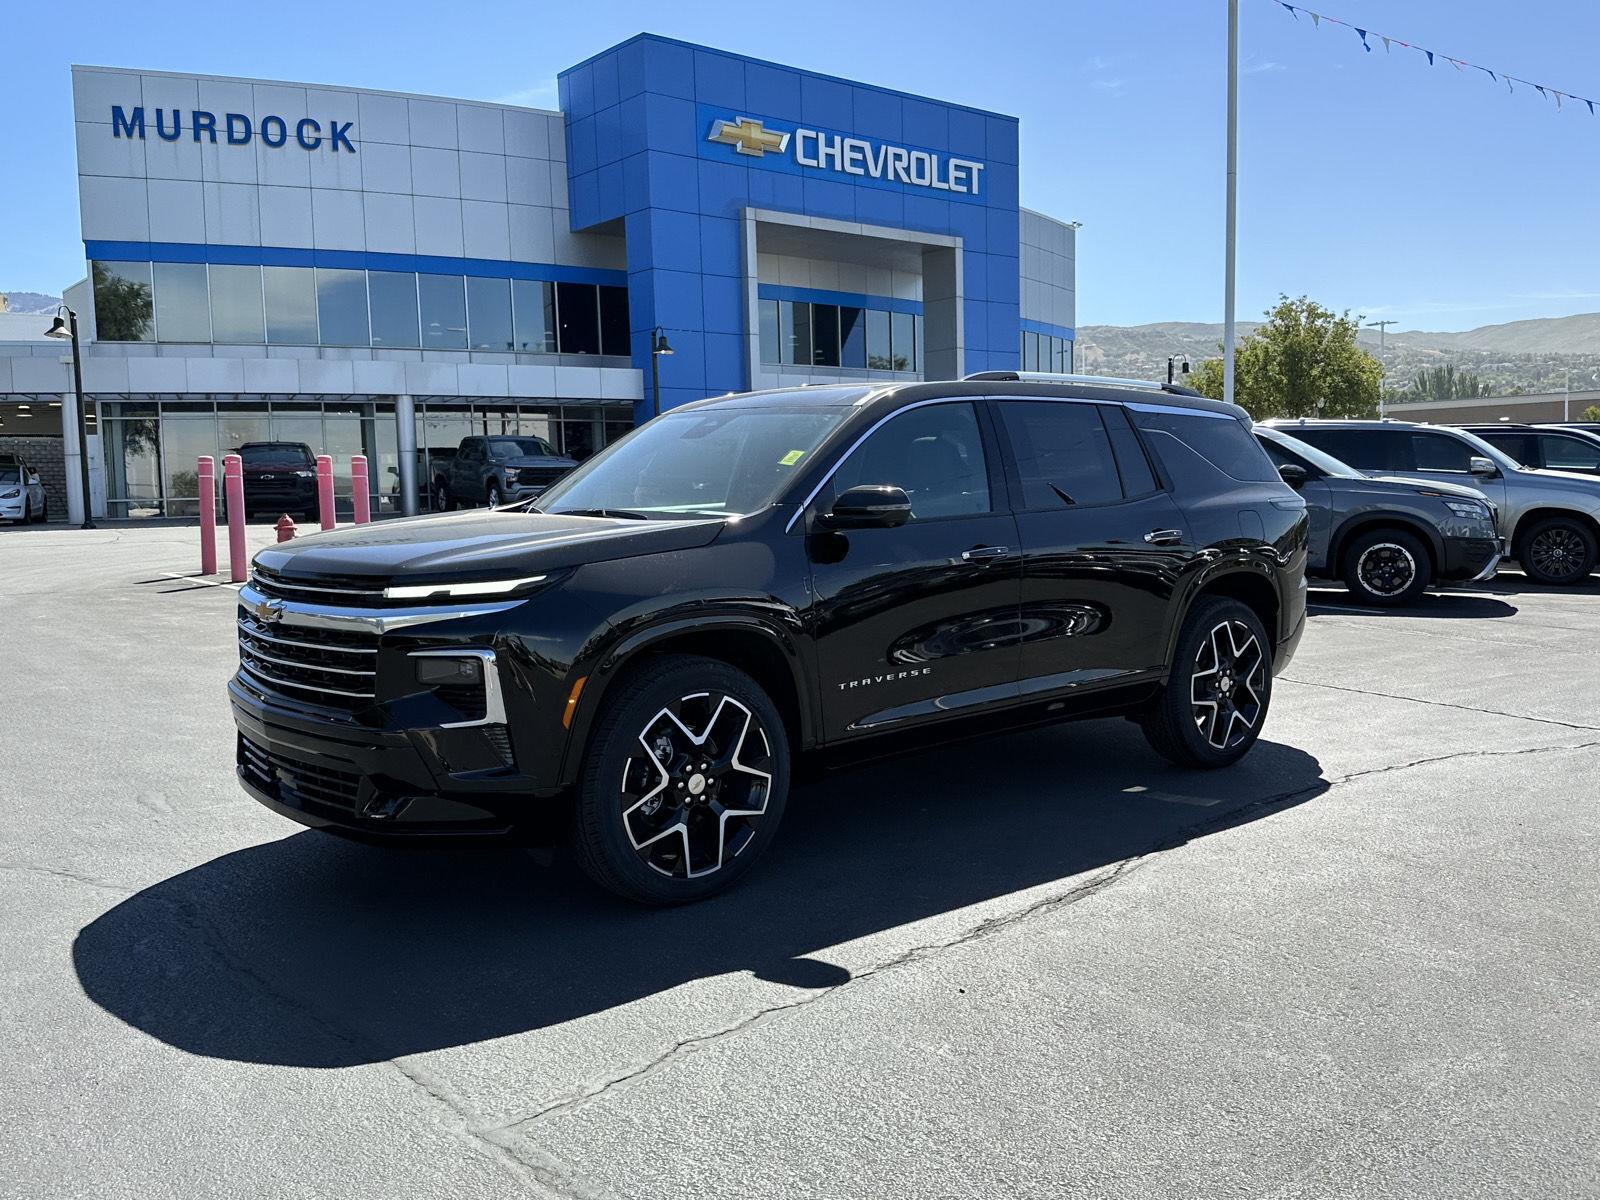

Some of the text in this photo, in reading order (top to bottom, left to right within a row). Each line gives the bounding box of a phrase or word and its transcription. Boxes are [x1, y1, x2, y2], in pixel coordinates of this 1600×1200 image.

[111, 105, 356, 153] MURDOCK
[795, 128, 984, 195] CHEVROLET
[838, 667, 932, 690] TRAVERSE
